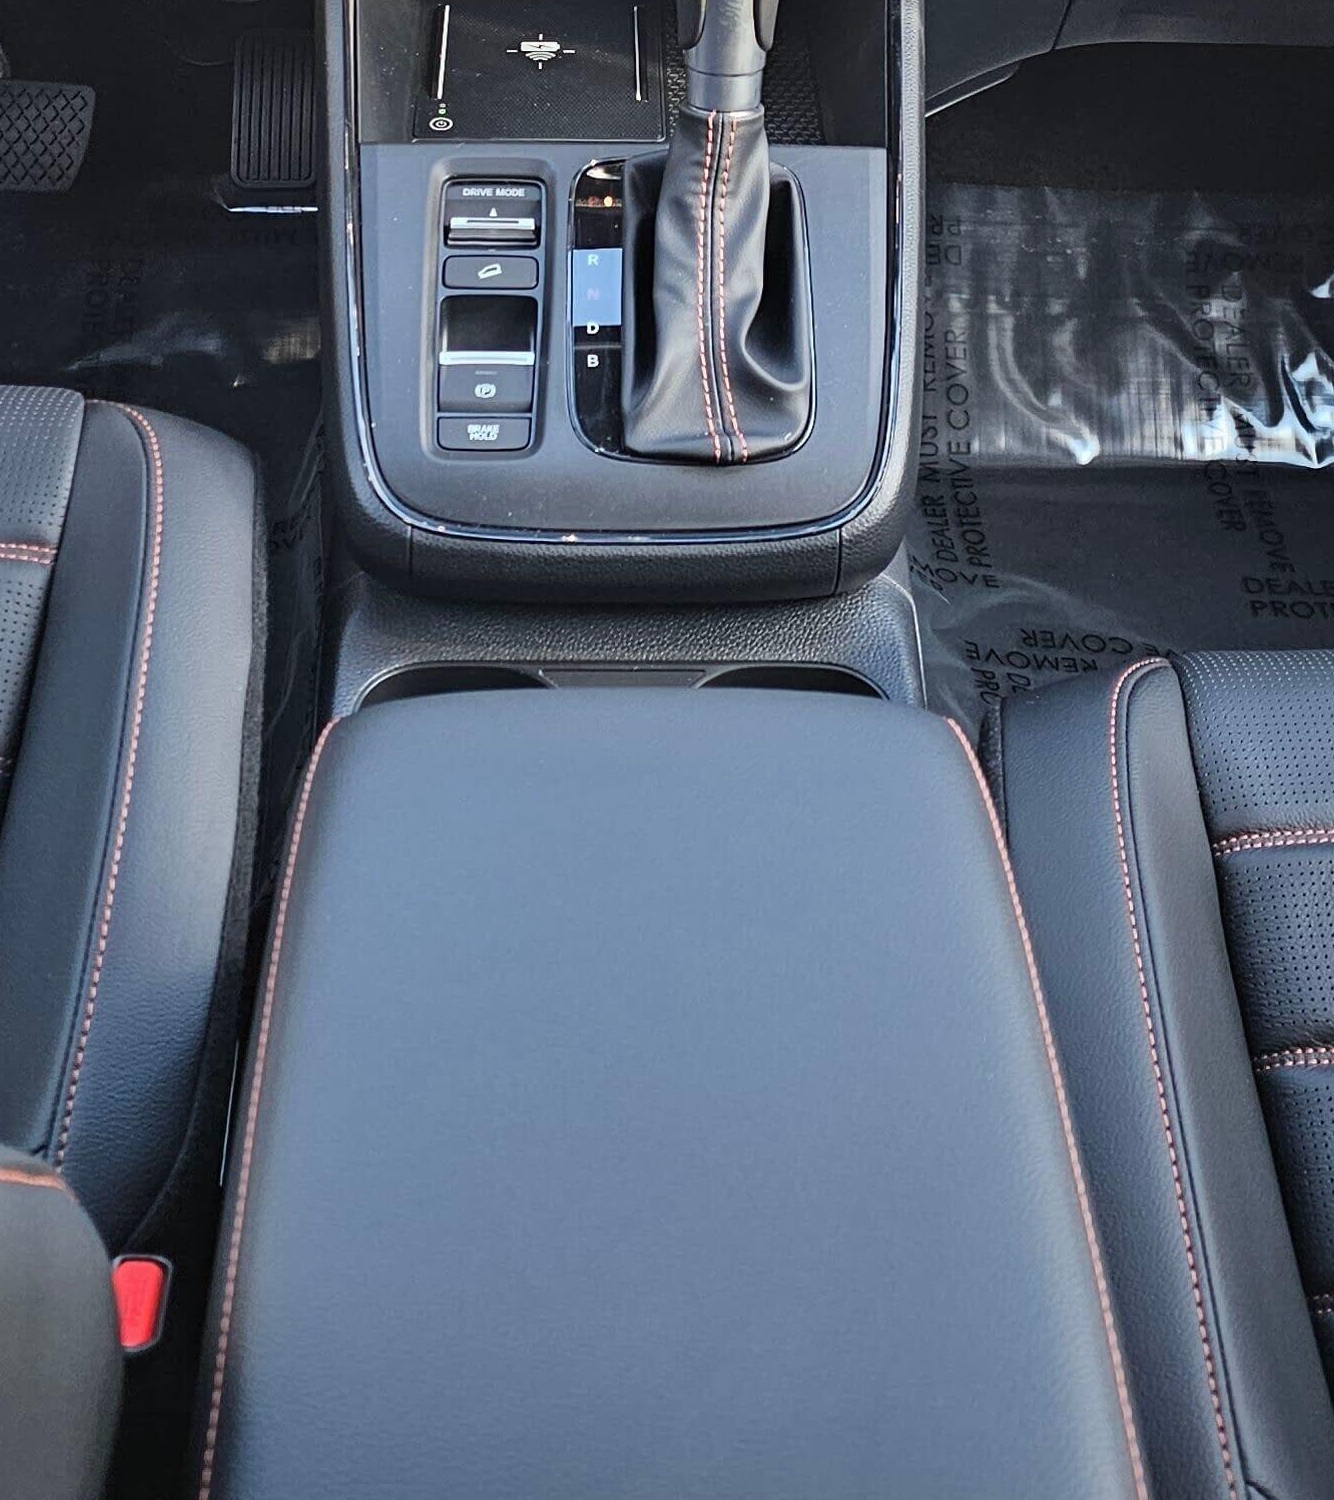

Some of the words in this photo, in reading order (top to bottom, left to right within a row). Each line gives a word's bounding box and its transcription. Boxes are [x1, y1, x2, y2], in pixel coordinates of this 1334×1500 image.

[462, 187, 493, 197] DRIVE
[495, 188, 525, 197] MODE
[586, 253, 599, 266] R
[586, 321, 600, 335] D
[586, 354, 600, 368] B
[944, 329, 971, 431] COVER
[467, 424, 500, 434] BRAKE
[945, 440, 993, 569] PROTECTIVE
[920, 494, 959, 563] DEALER
[1020, 628, 1134, 655] COVER
[963, 639, 1099, 674] REMOVE
